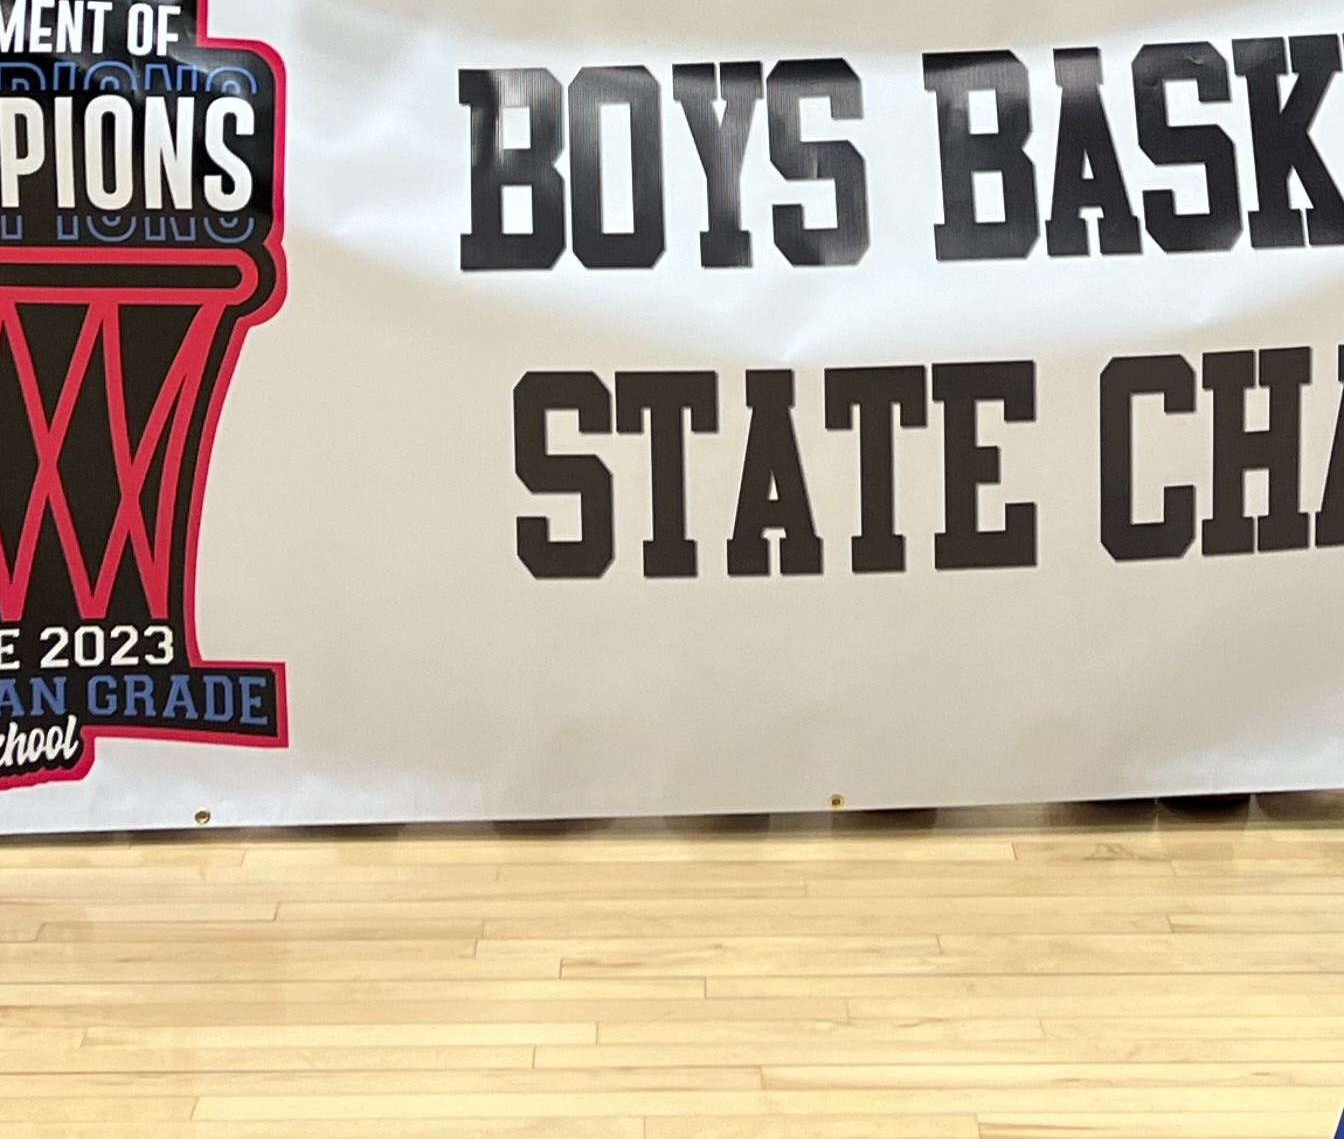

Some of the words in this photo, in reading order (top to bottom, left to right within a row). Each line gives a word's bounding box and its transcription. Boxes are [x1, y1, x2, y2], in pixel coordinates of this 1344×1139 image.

[126, 2, 181, 57] OF
[457, 57, 870, 271] BOYS
[512, 359, 1038, 579] STATE
[39, 625, 175, 669] 2023
[87, 673, 269, 726] GRADE
